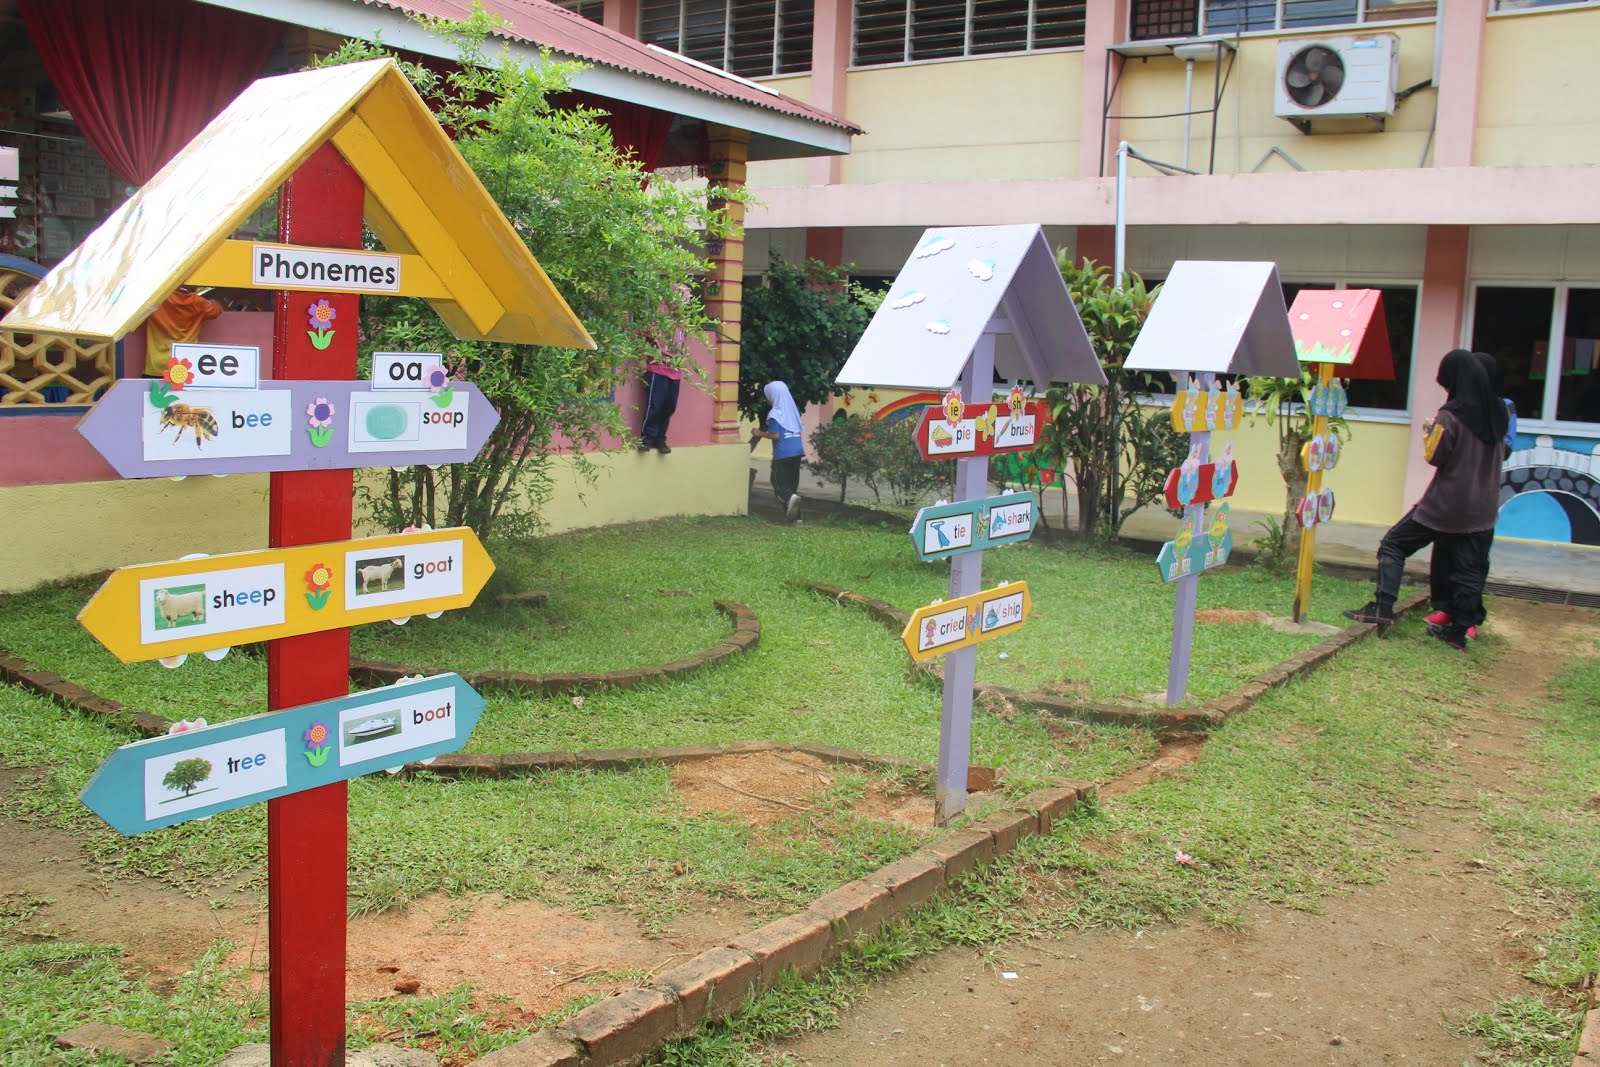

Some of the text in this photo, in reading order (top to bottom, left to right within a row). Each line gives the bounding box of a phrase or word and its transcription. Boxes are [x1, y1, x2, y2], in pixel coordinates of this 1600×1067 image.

[259, 252, 396, 285] Phonemes
[197, 353, 240, 377] ee
[388, 361, 422, 382] oa
[950, 402, 959, 417] ie
[1012, 398, 1022, 411] sh
[231, 410, 273, 430] bee
[422, 409, 464, 428] soap
[956, 426, 971, 444] pie
[1010, 423, 1034, 437] brush
[1007, 510, 1030, 526] shark
[954, 524, 966, 539] tie
[413, 556, 453, 580] goat
[213, 588, 276, 609] sheep
[1002, 602, 1021, 618] ship
[940, 616, 965, 635] cried
[413, 702, 452, 725] boat
[227, 753, 267, 774] tree
